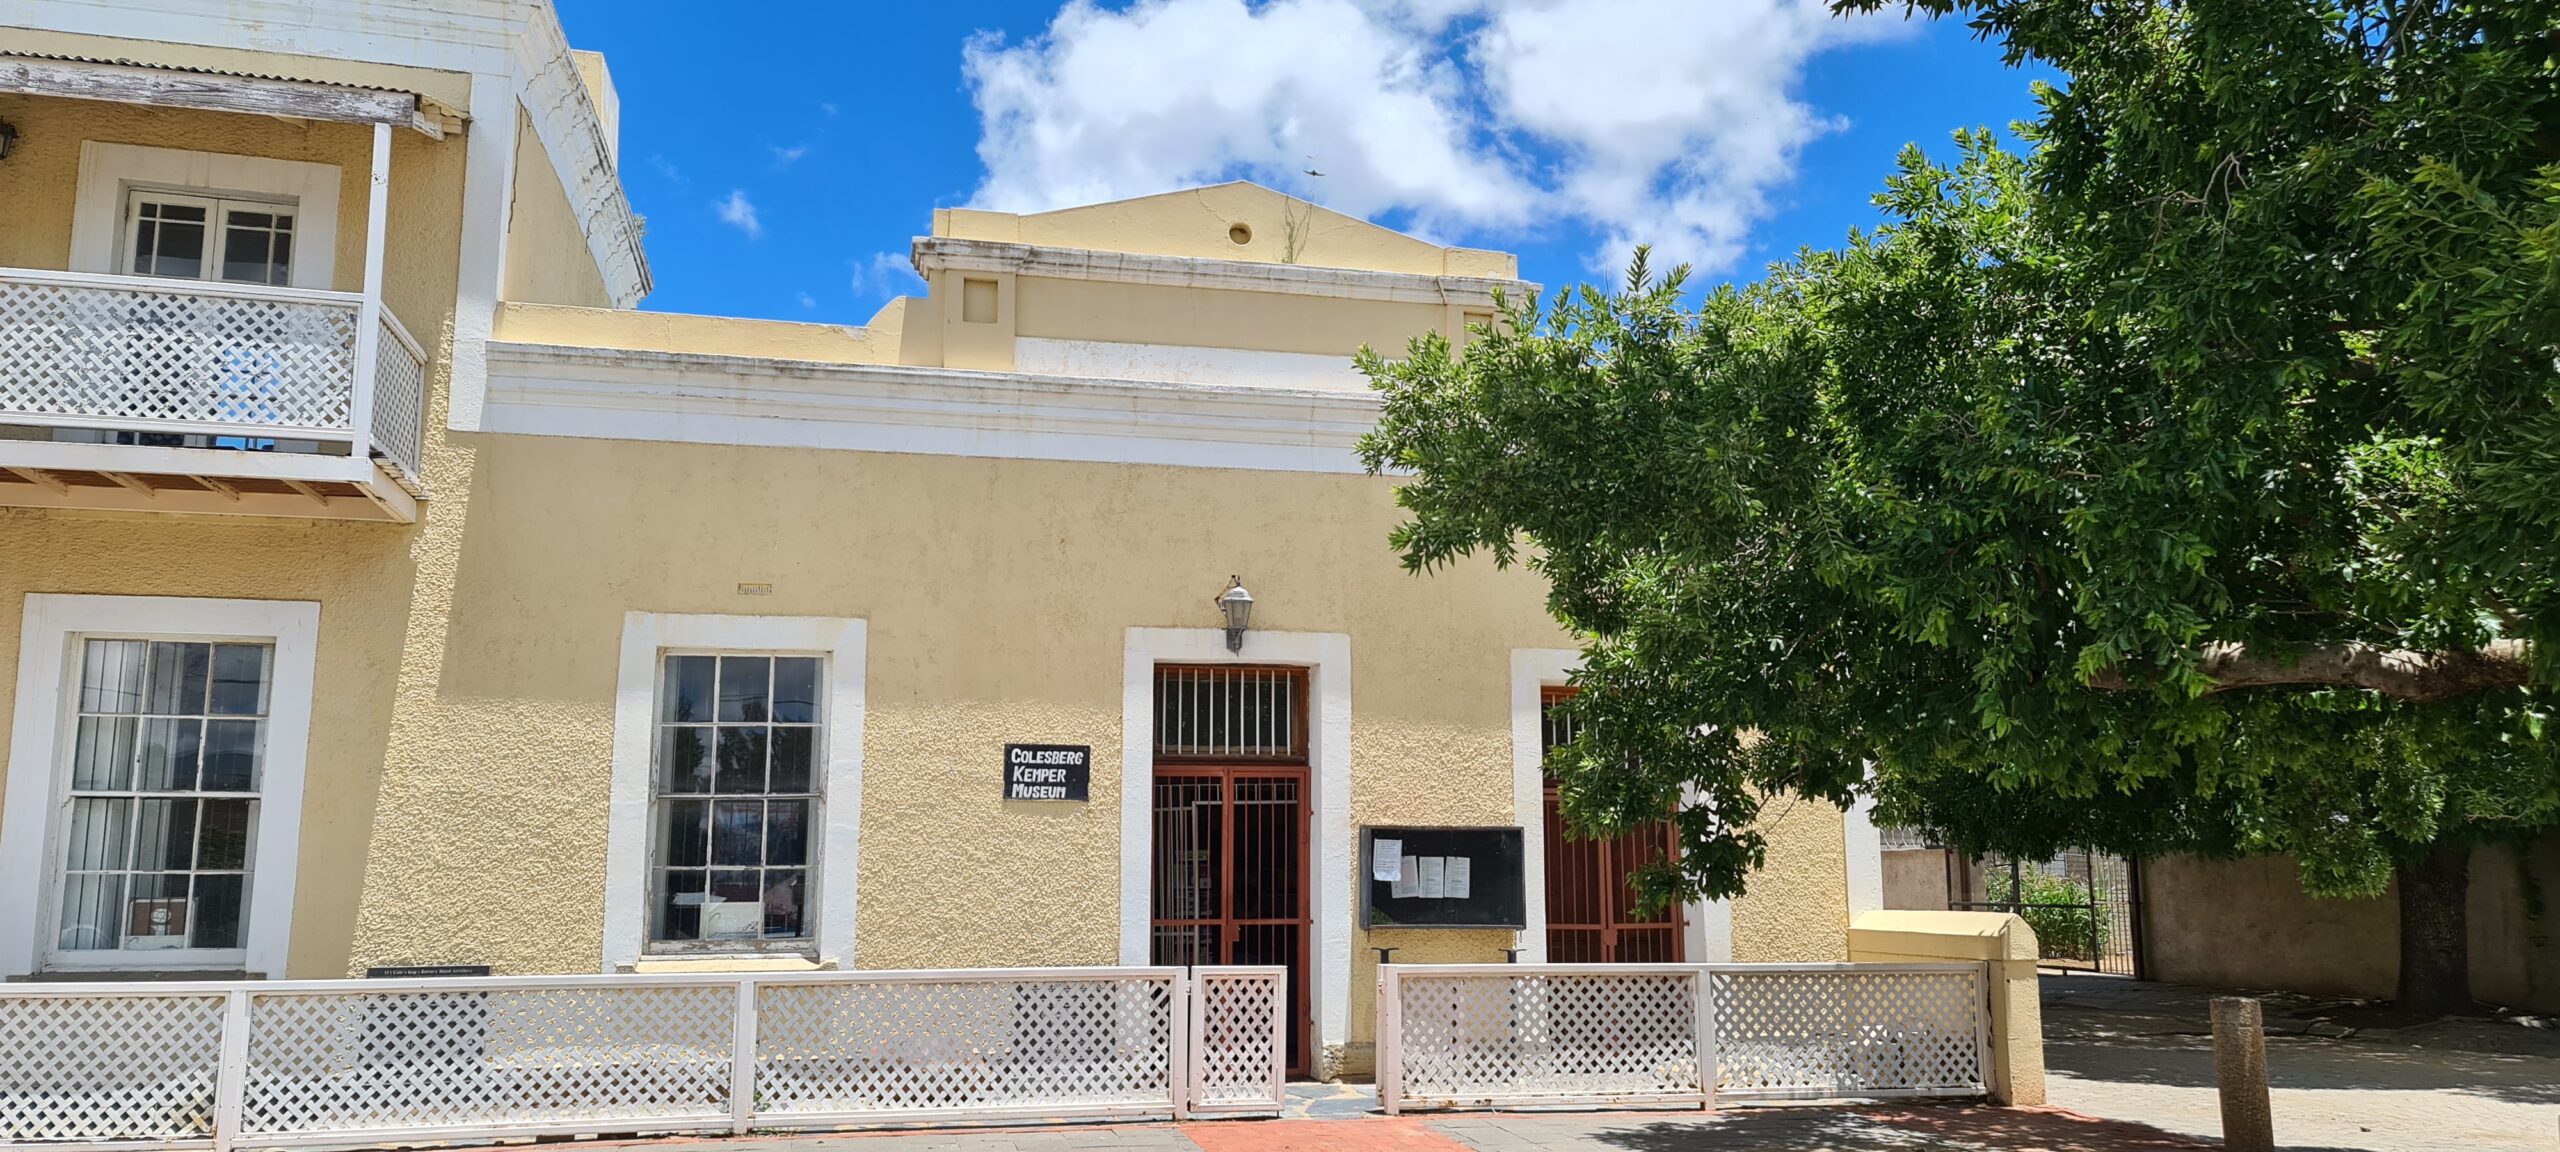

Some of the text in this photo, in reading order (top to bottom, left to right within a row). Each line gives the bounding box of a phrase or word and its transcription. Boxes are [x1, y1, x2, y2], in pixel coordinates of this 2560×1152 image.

[1011, 748, 1084, 765] COLESBERG
[1013, 766, 1066, 783] KEMPER
[1011, 783, 1067, 799] MUSEUM
